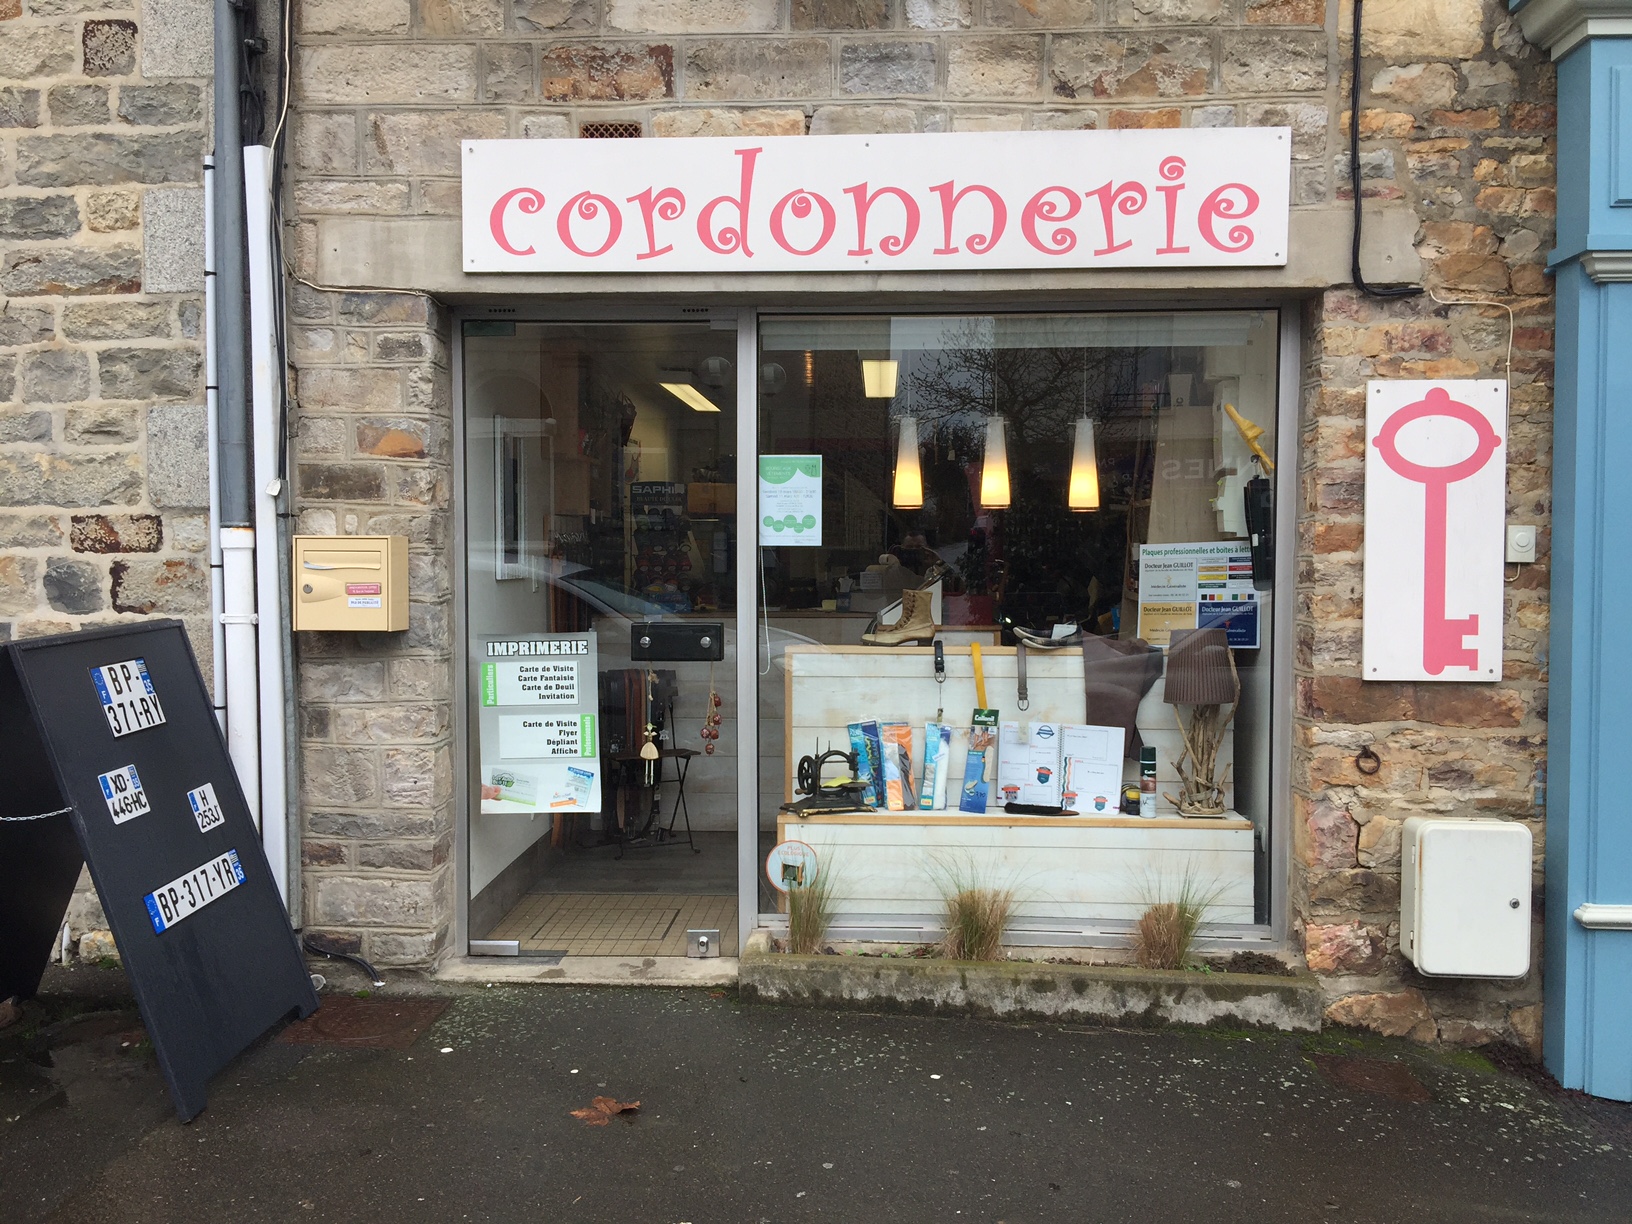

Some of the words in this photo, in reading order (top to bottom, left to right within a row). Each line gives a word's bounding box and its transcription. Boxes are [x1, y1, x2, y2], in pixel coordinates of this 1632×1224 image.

[489, 147, 1260, 260] cordonnerie
[632, 485, 684, 494] SAPHI
[1142, 548, 1163, 556] Plaques
[1164, 547, 1208, 556] professionnelles
[487, 640, 588, 656] IMPRIMERIE
[108, 664, 139, 695] BP-
[108, 695, 162, 734] 371-RY
[110, 774, 129, 794] XD-
[112, 791, 147, 818] 446-HC
[199, 790, 209, 807] H
[157, 858, 236, 923] BP-317-YR
